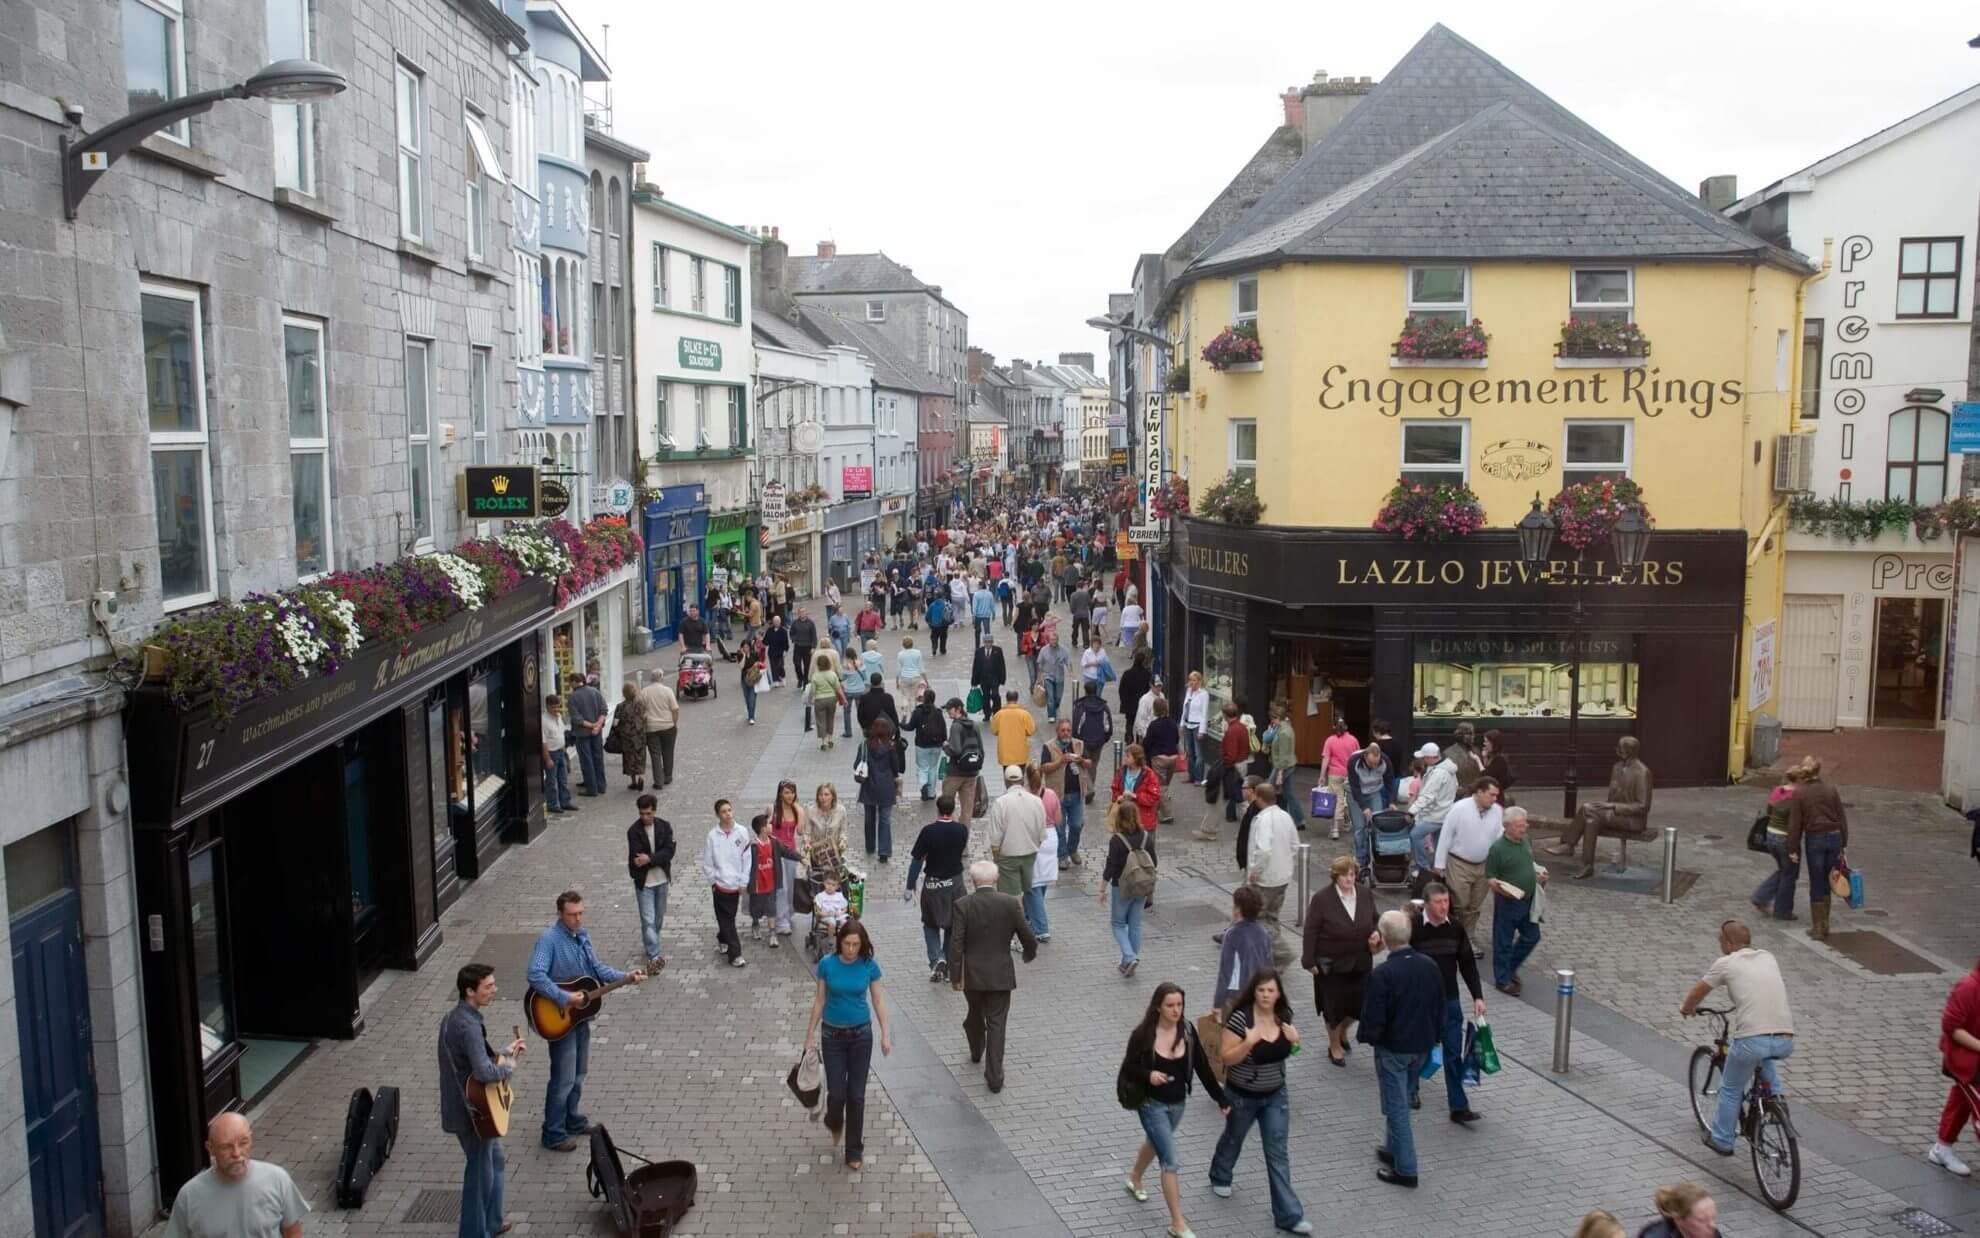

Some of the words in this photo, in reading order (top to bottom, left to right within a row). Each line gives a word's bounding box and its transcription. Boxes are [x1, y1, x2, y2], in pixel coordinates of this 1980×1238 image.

[1318, 364, 1609, 418] Engagement
[1622, 364, 1743, 418] Rings
[1147, 396, 1161, 522] NEWSAGENS
[474, 496, 528, 510] ROLEX
[1129, 530, 1160, 539] O'BRIEN
[1337, 559, 1465, 585] LAZLO
[196, 739, 216, 770] 27
